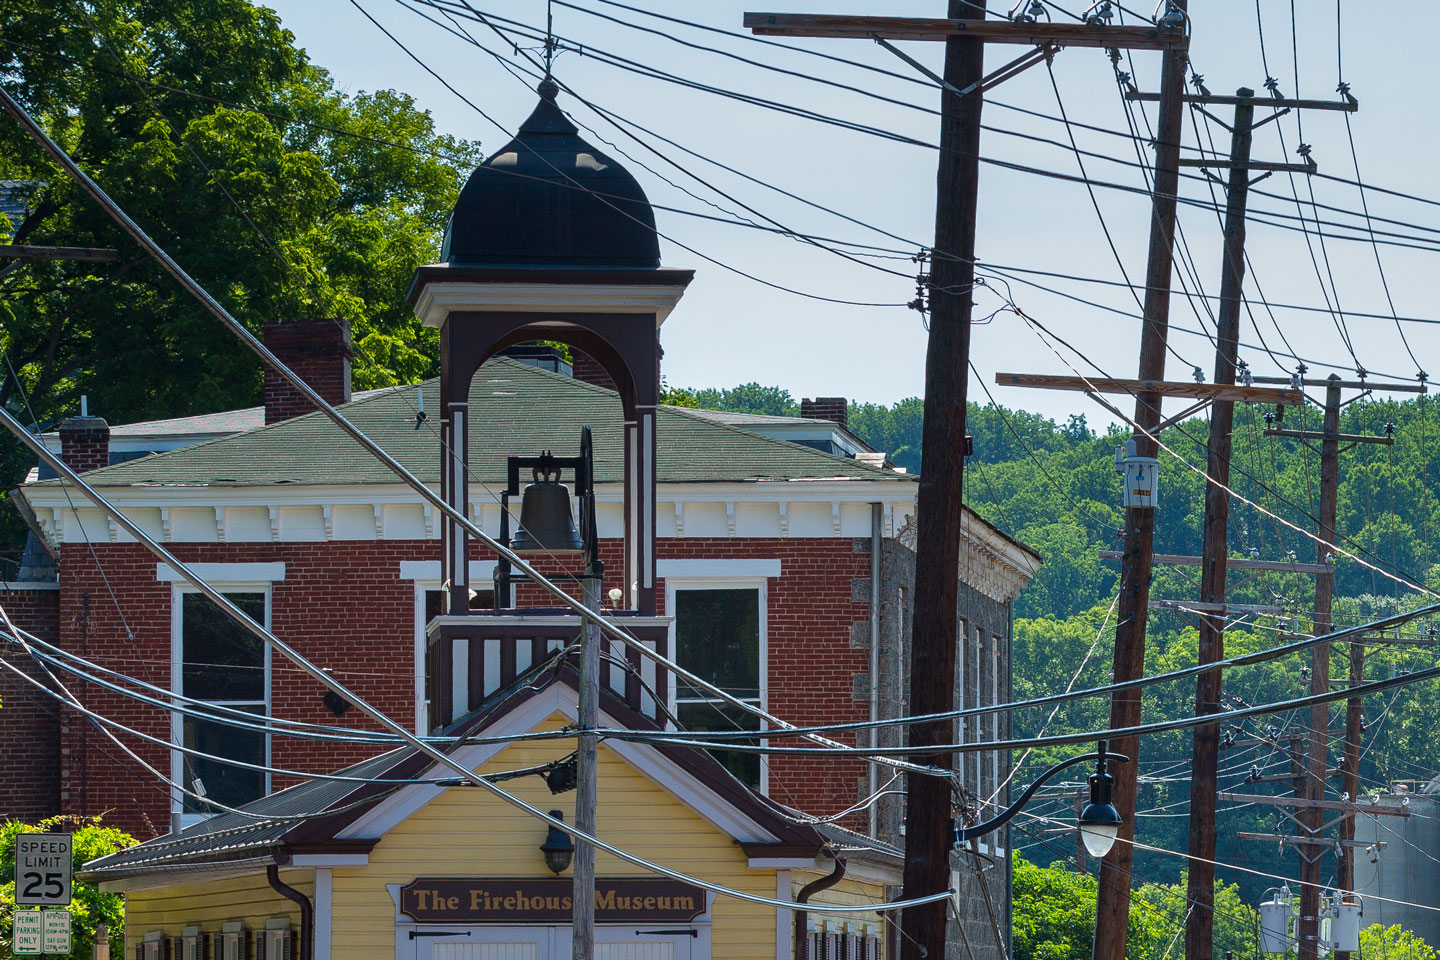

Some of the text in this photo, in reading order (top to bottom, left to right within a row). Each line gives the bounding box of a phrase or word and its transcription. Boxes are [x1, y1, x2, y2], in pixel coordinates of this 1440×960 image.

[20, 842, 68, 853] SPEED
[25, 857, 61, 868] LIMIT
[22, 872, 64, 899] 25
[413, 889, 695, 911] The Firehous Museum
[16, 927, 40, 935] PARKING
